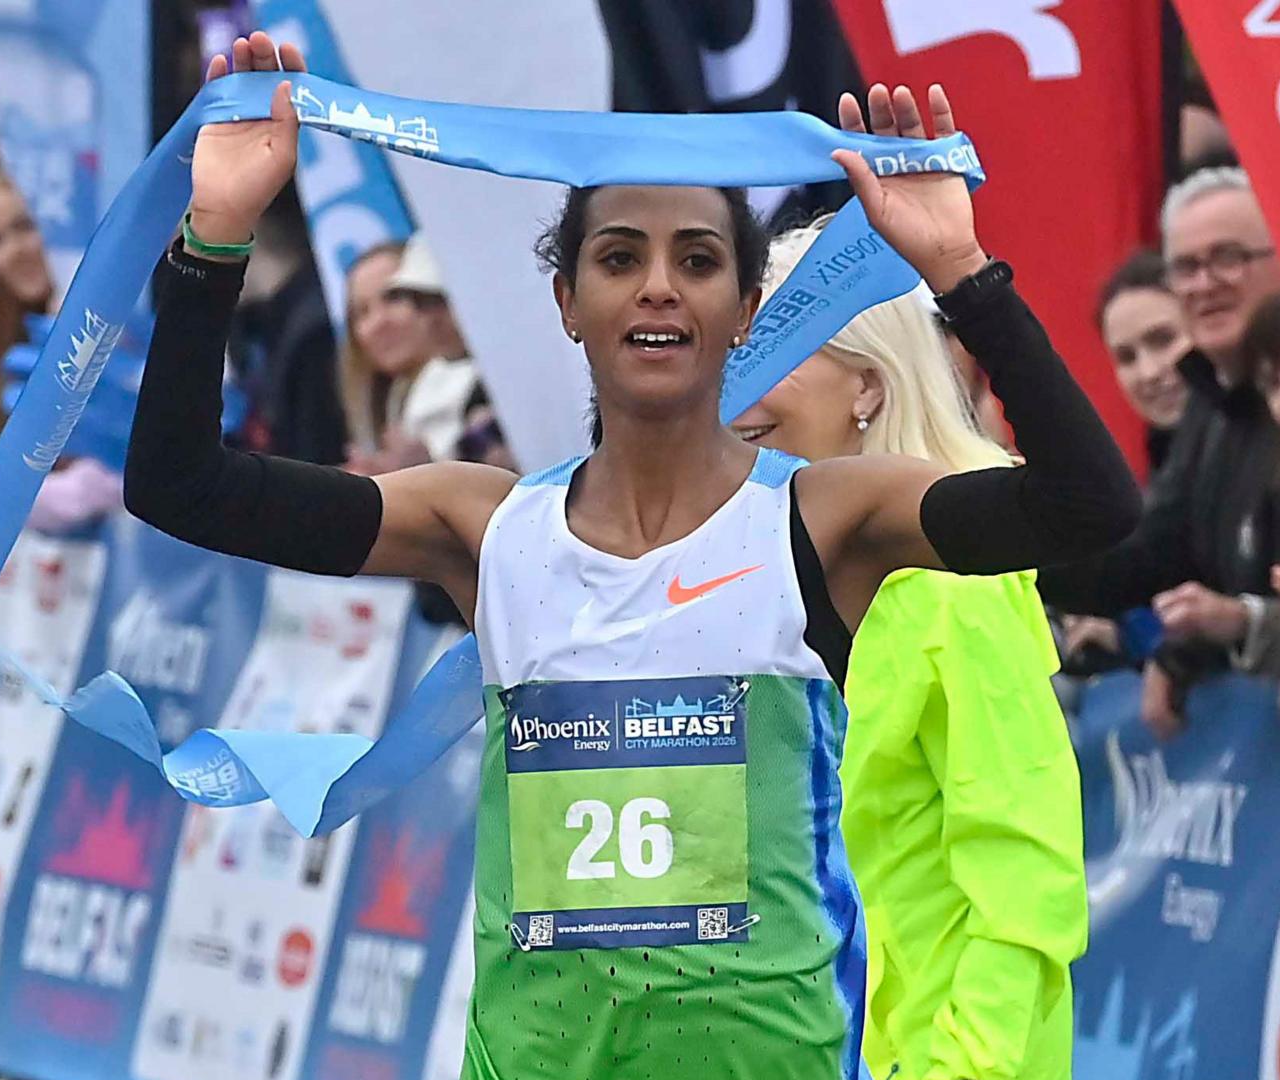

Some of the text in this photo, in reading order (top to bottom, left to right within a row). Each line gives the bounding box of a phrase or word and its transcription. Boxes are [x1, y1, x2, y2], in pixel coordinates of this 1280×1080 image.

[874, 143, 981, 177] Phoen
[524, 714, 611, 740] Phoenix
[625, 715, 736, 738] BELFAST
[573, 739, 611, 752] Energy
[625, 736, 737, 750] CITY MARATHON 2026
[564, 797, 675, 881] 26
[558, 921, 690, 934] www.belfastcitymarathon.com
